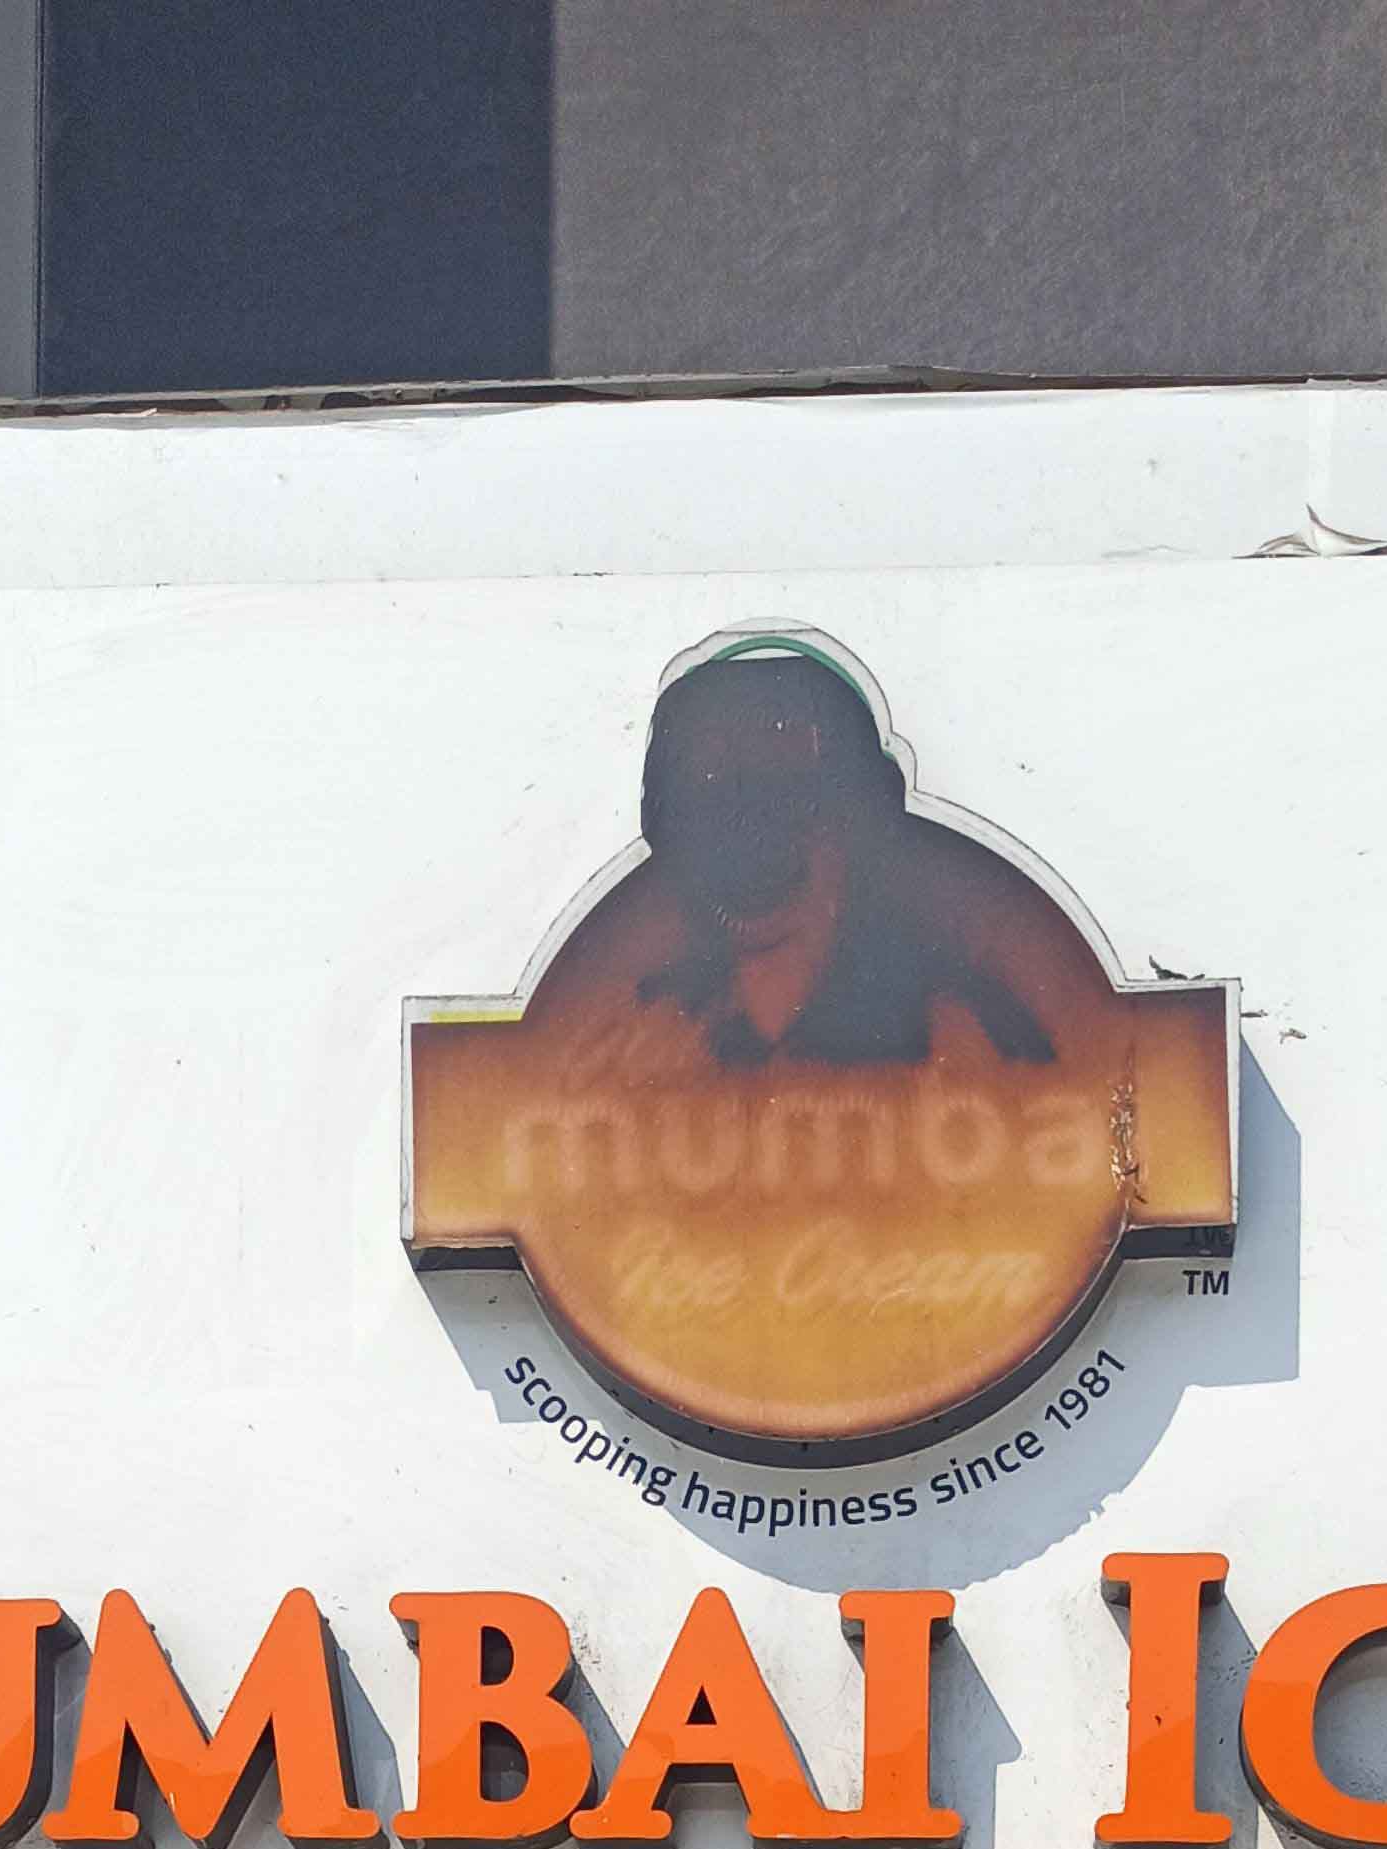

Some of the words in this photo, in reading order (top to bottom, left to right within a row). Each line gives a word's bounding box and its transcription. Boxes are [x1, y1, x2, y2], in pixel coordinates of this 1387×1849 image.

[1182, 1270, 1229, 1296] TM
[504, 1355, 678, 1507] scooping
[683, 1479, 919, 1537] happiness
[928, 1426, 1045, 1503] since
[1042, 1350, 1128, 1429] 1981
